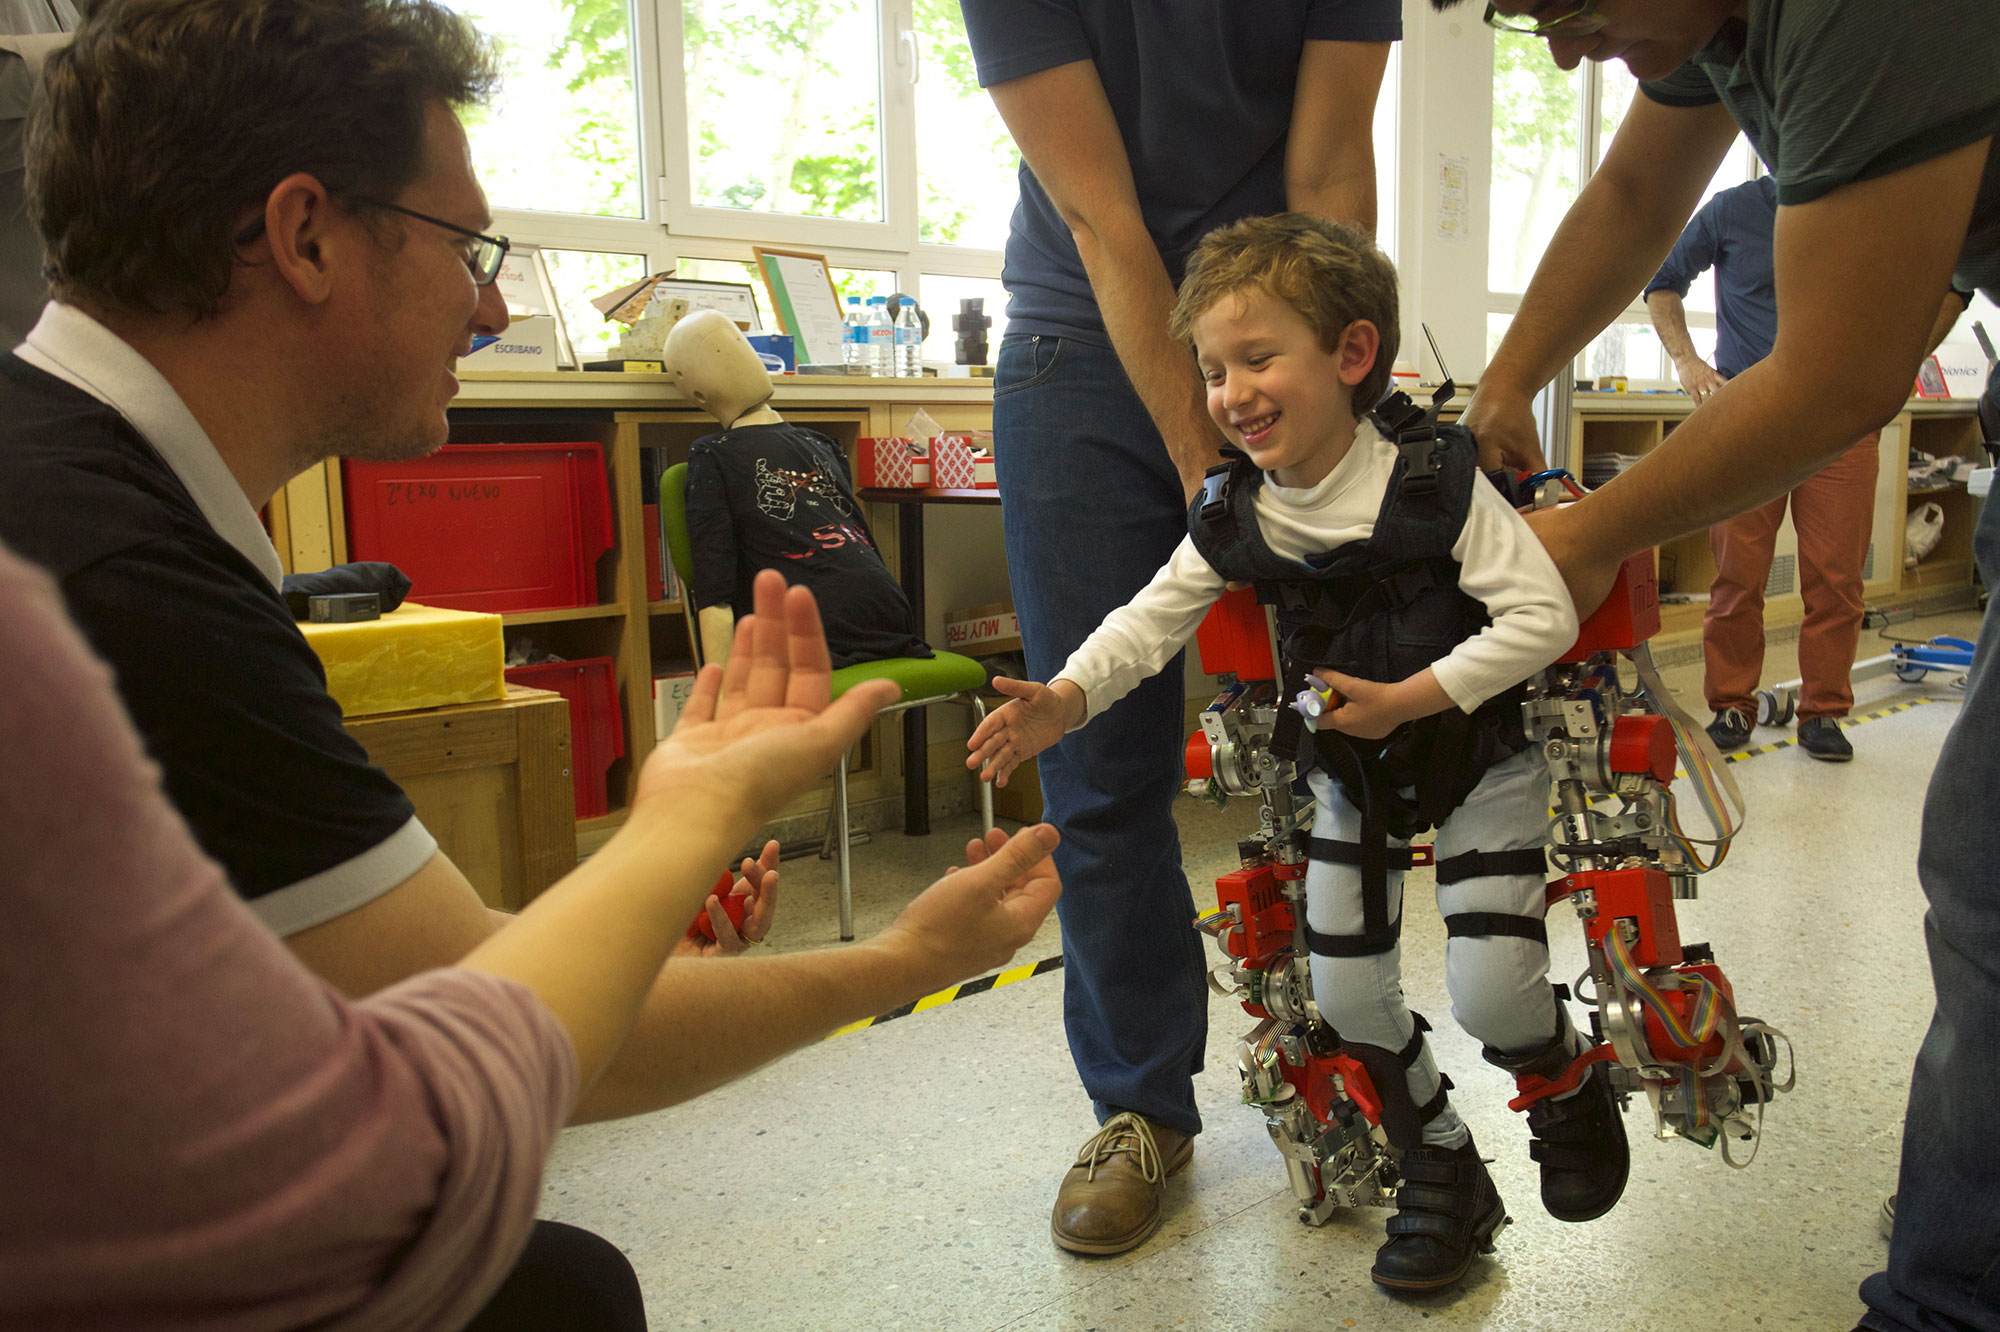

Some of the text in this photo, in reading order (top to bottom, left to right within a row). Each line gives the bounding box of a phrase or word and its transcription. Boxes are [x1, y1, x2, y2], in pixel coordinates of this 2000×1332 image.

[494, 344, 542, 355] ESCRIBANO
[406, 482, 437, 504] EXO
[448, 483, 500, 502] NUEVO
[970, 619, 999, 640] MUY
